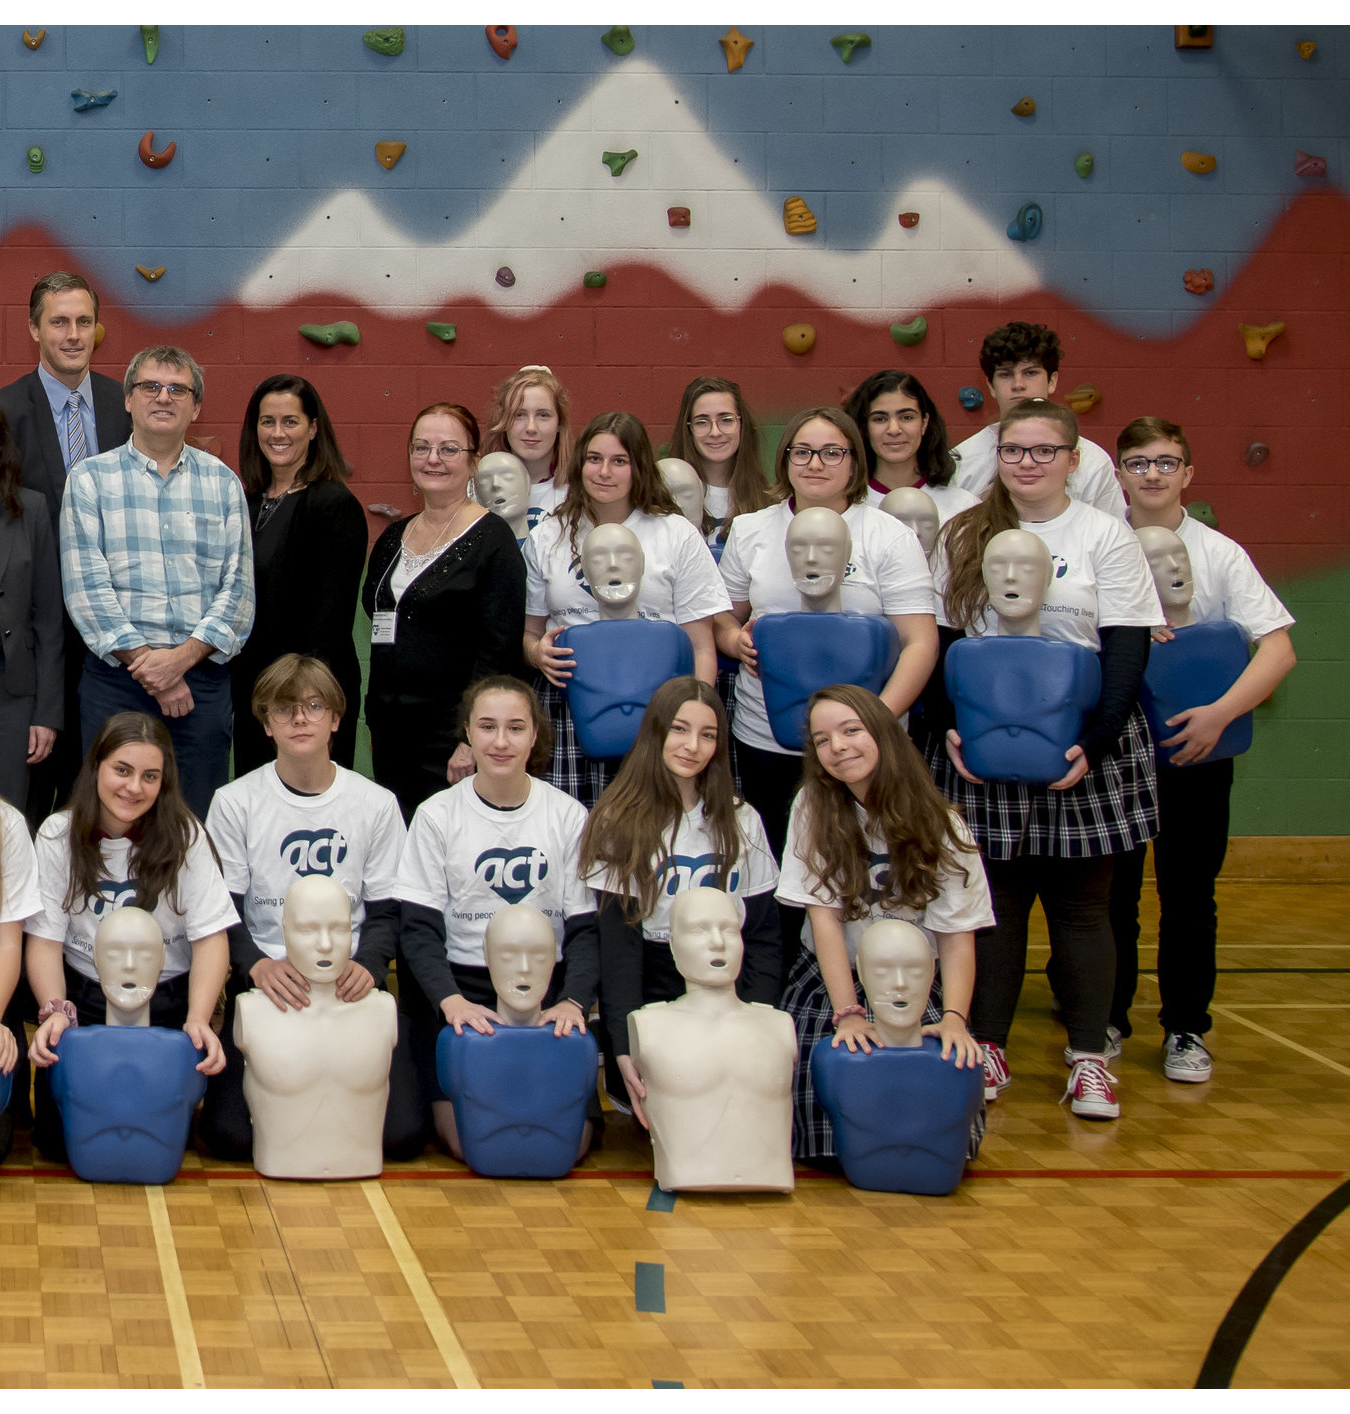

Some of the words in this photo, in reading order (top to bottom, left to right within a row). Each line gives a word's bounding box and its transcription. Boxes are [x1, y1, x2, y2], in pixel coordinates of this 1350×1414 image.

[1044, 604, 1079, 616] Touching
[1080, 609, 1094, 618] lives
[281, 832, 347, 872] act
[475, 849, 549, 889] act
[254, 896, 277, 906] Saving
